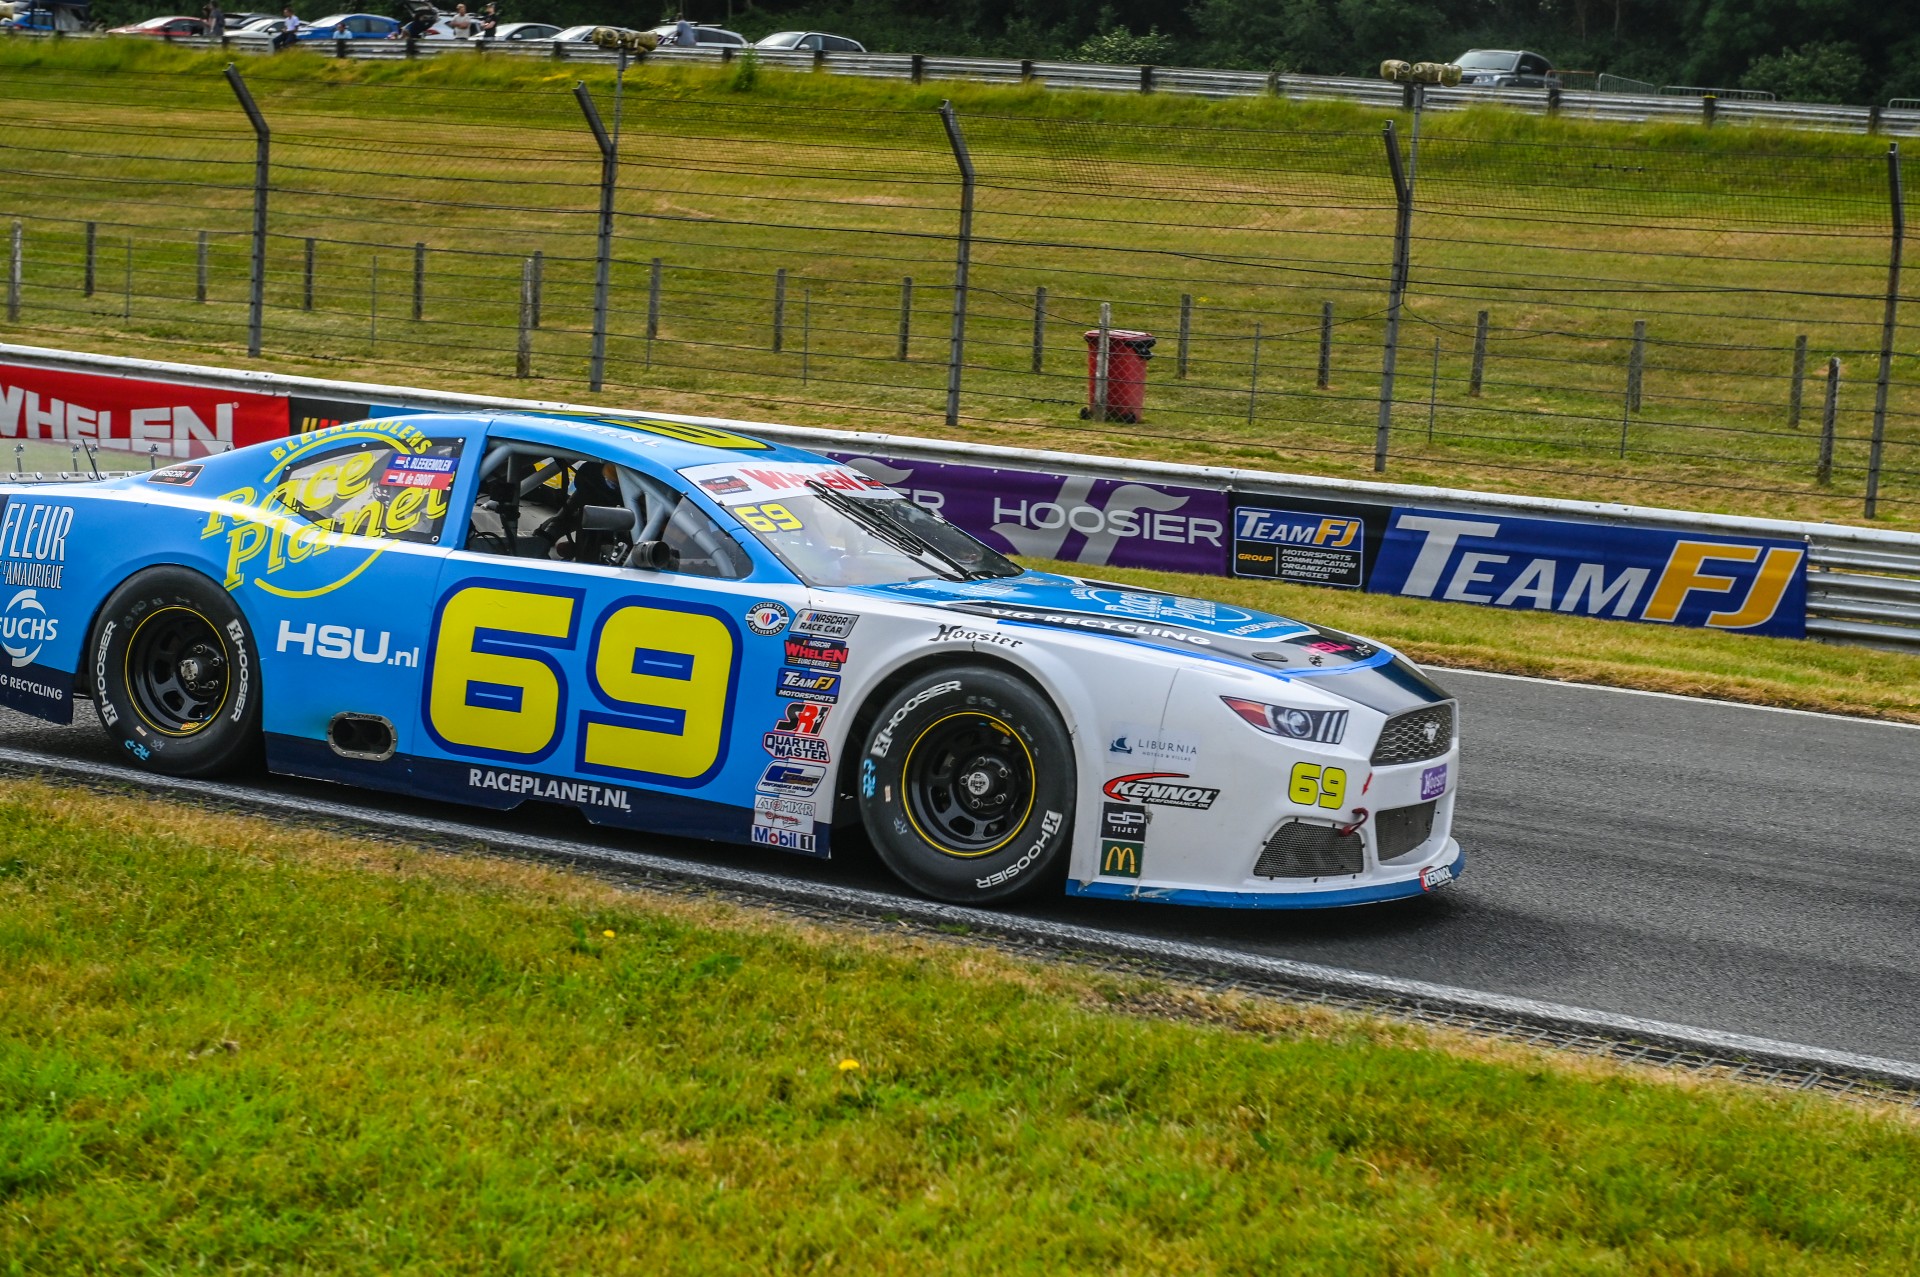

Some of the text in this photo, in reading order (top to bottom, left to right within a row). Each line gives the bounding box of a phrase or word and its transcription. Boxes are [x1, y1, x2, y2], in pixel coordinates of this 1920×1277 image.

[271, 420, 433, 460] BLEEKEMOLENS
[200, 452, 376, 540] Race
[734, 502, 803, 532] 69
[993, 498, 1224, 547] HOOSIER
[224, 472, 455, 592] Planet
[1238, 553, 1274, 562] GROUP
[1281, 555, 1356, 569] COMMUNICATION
[1282, 549, 1352, 561] MOTORSPORTS
[1281, 562, 1349, 574] ORGANIZATION
[1281, 569, 1330, 580] ENERGIES
[0, 616, 59, 641] UCHS
[799, 623, 843, 634] RACE CAR
[814, 613, 848, 626] NASCAR
[991, 608, 1212, 646] VG RECYCLING
[276, 620, 419, 668] HSU.nl
[928, 624, 1023, 648] Hoosier
[97, 620, 118, 702] HOOSIER
[785, 642, 849, 664] WHELEN
[10, 676, 63, 700] RECYCLING
[229, 637, 250, 722] HOOSIER
[424, 579, 740, 786] 69
[779, 689, 835, 702] MOTORSPORTS
[883, 680, 961, 736] HOOSIER
[765, 734, 825, 751] QUARTER
[775, 747, 827, 760] MASTER
[1138, 739, 1198, 754] LIBURNIA
[469, 768, 630, 810] RACEPLANET.NL
[1111, 780, 1215, 803] KENNOL
[1288, 761, 1347, 810] 69
[754, 826, 814, 850] Mobil 1
[1112, 825, 1138, 834] TIJEY
[975, 830, 1054, 889] HOOSIER
